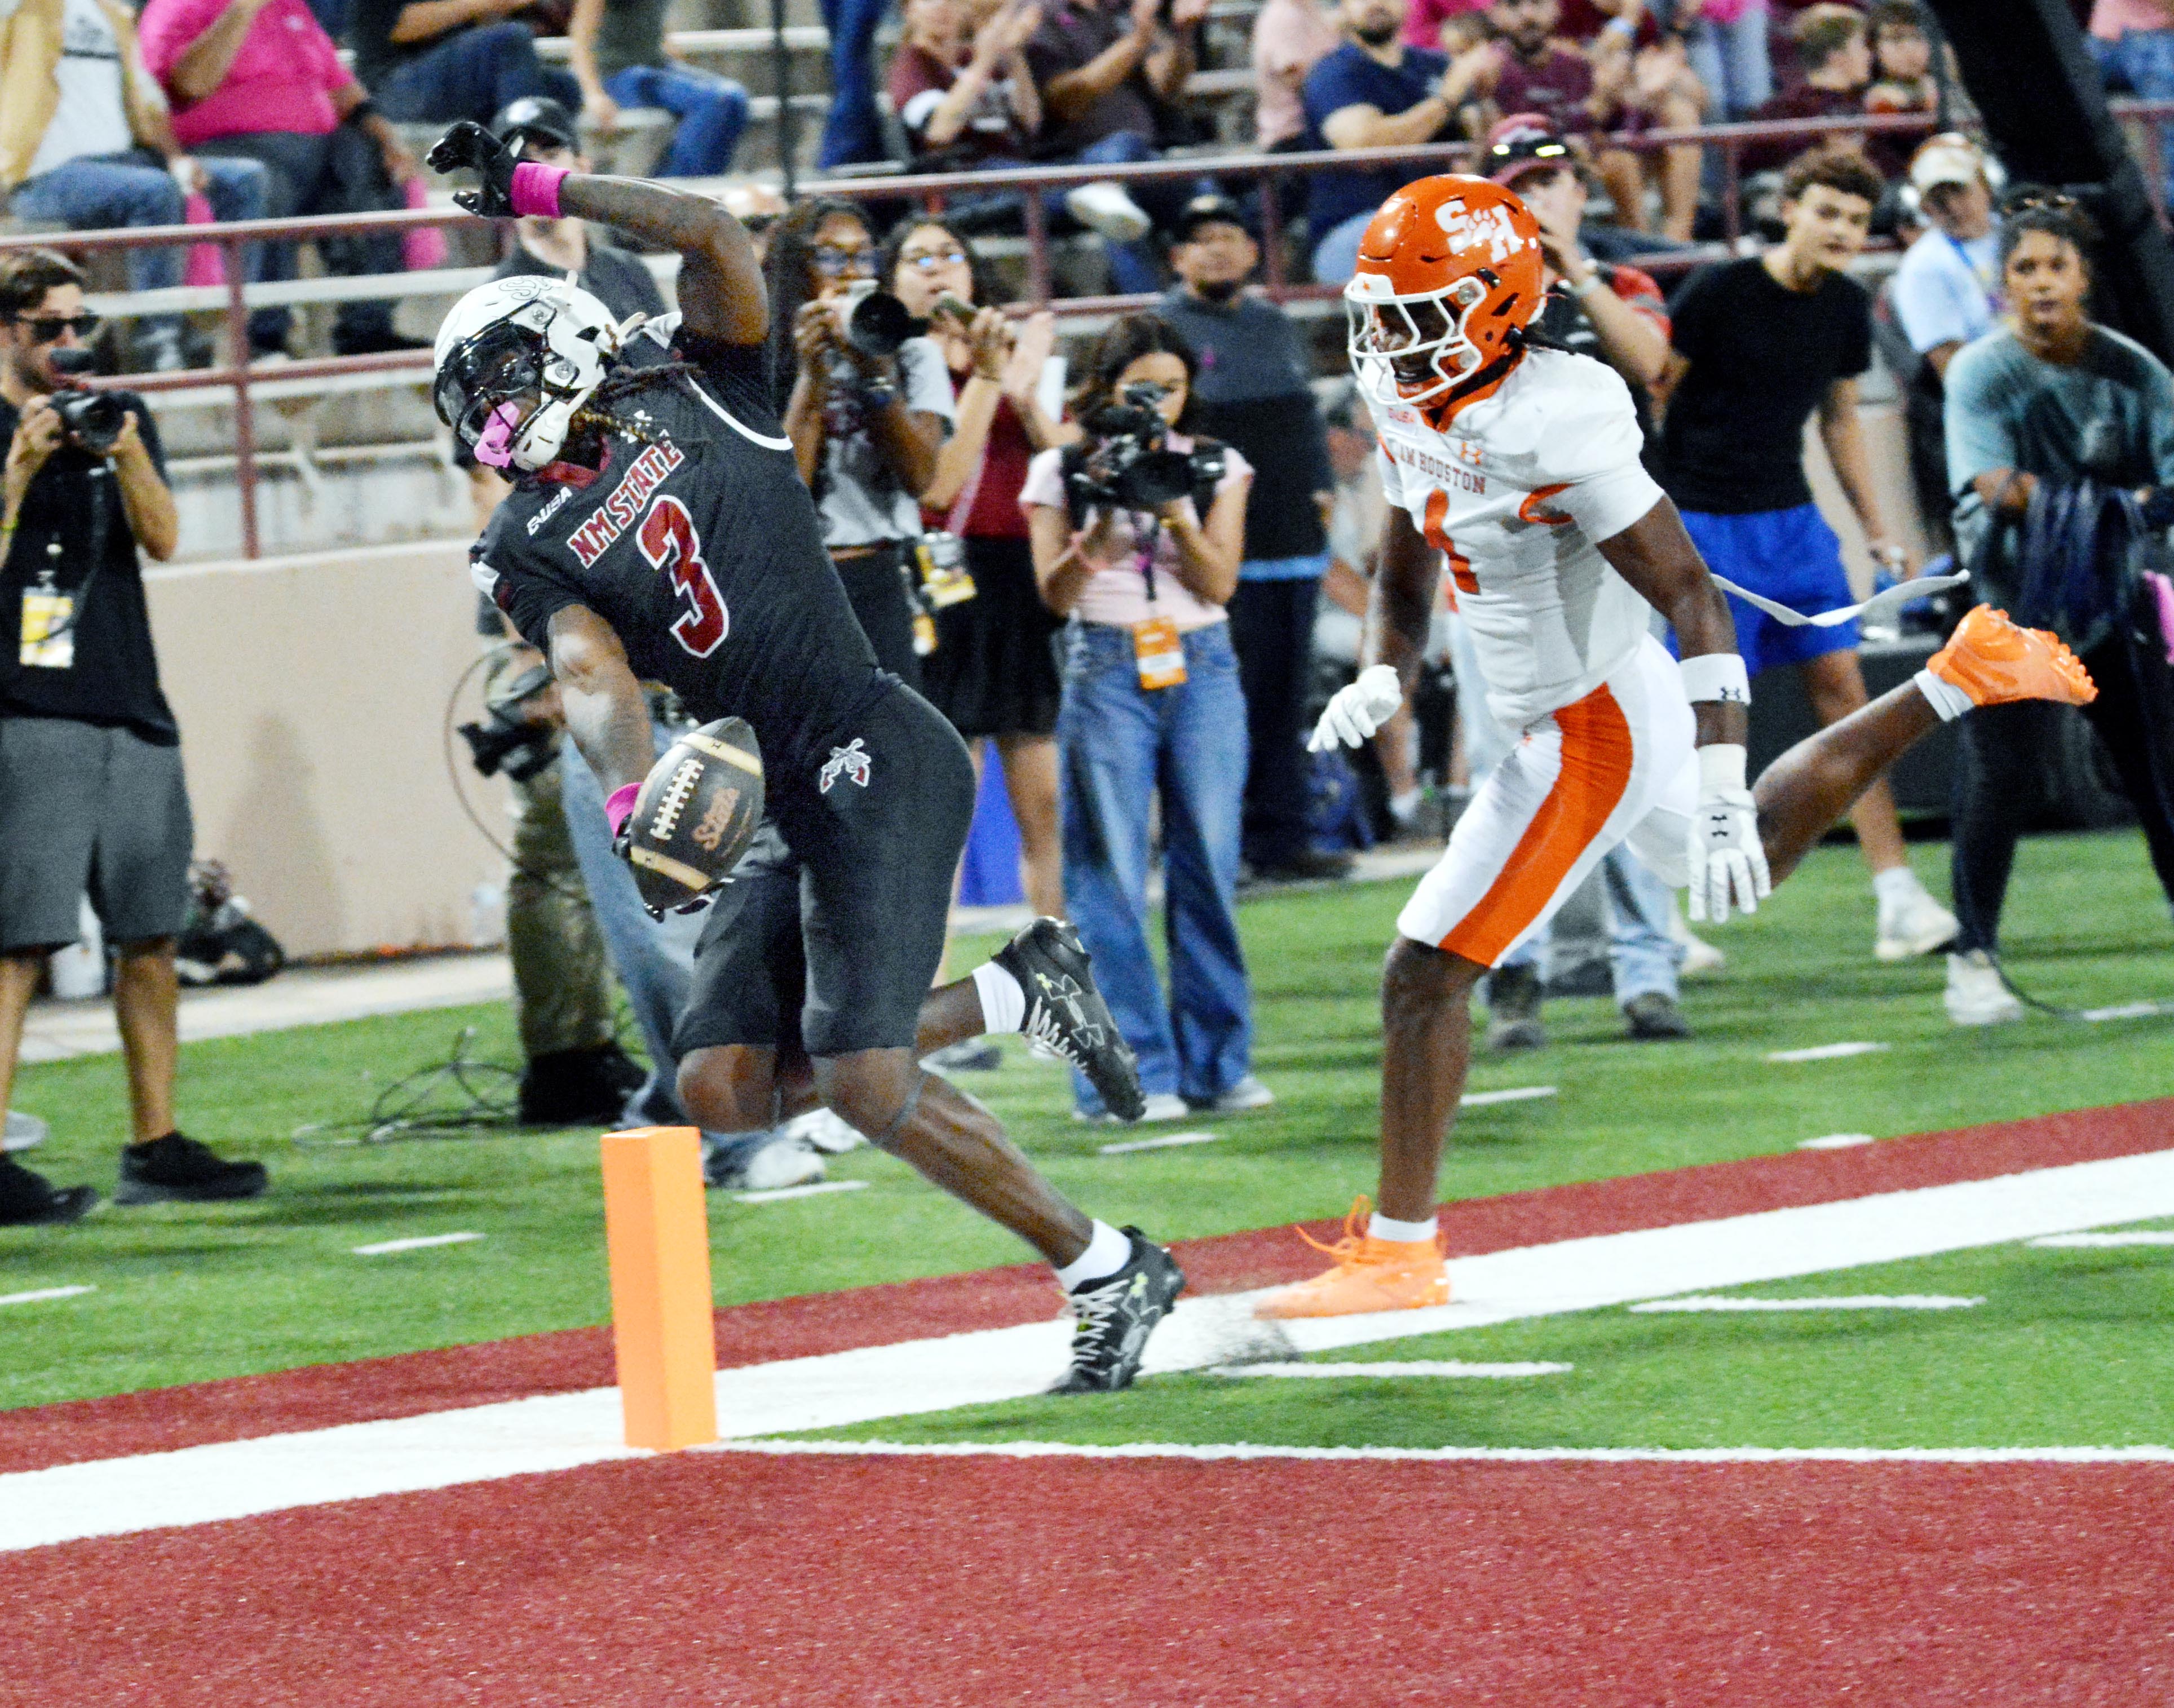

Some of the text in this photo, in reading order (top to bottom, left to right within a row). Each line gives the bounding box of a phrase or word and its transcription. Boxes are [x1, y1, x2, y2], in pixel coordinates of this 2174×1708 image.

[567, 429, 685, 569] NM STATE
[1419, 451, 1486, 495] HOUSTON
[636, 494, 729, 658] 3
